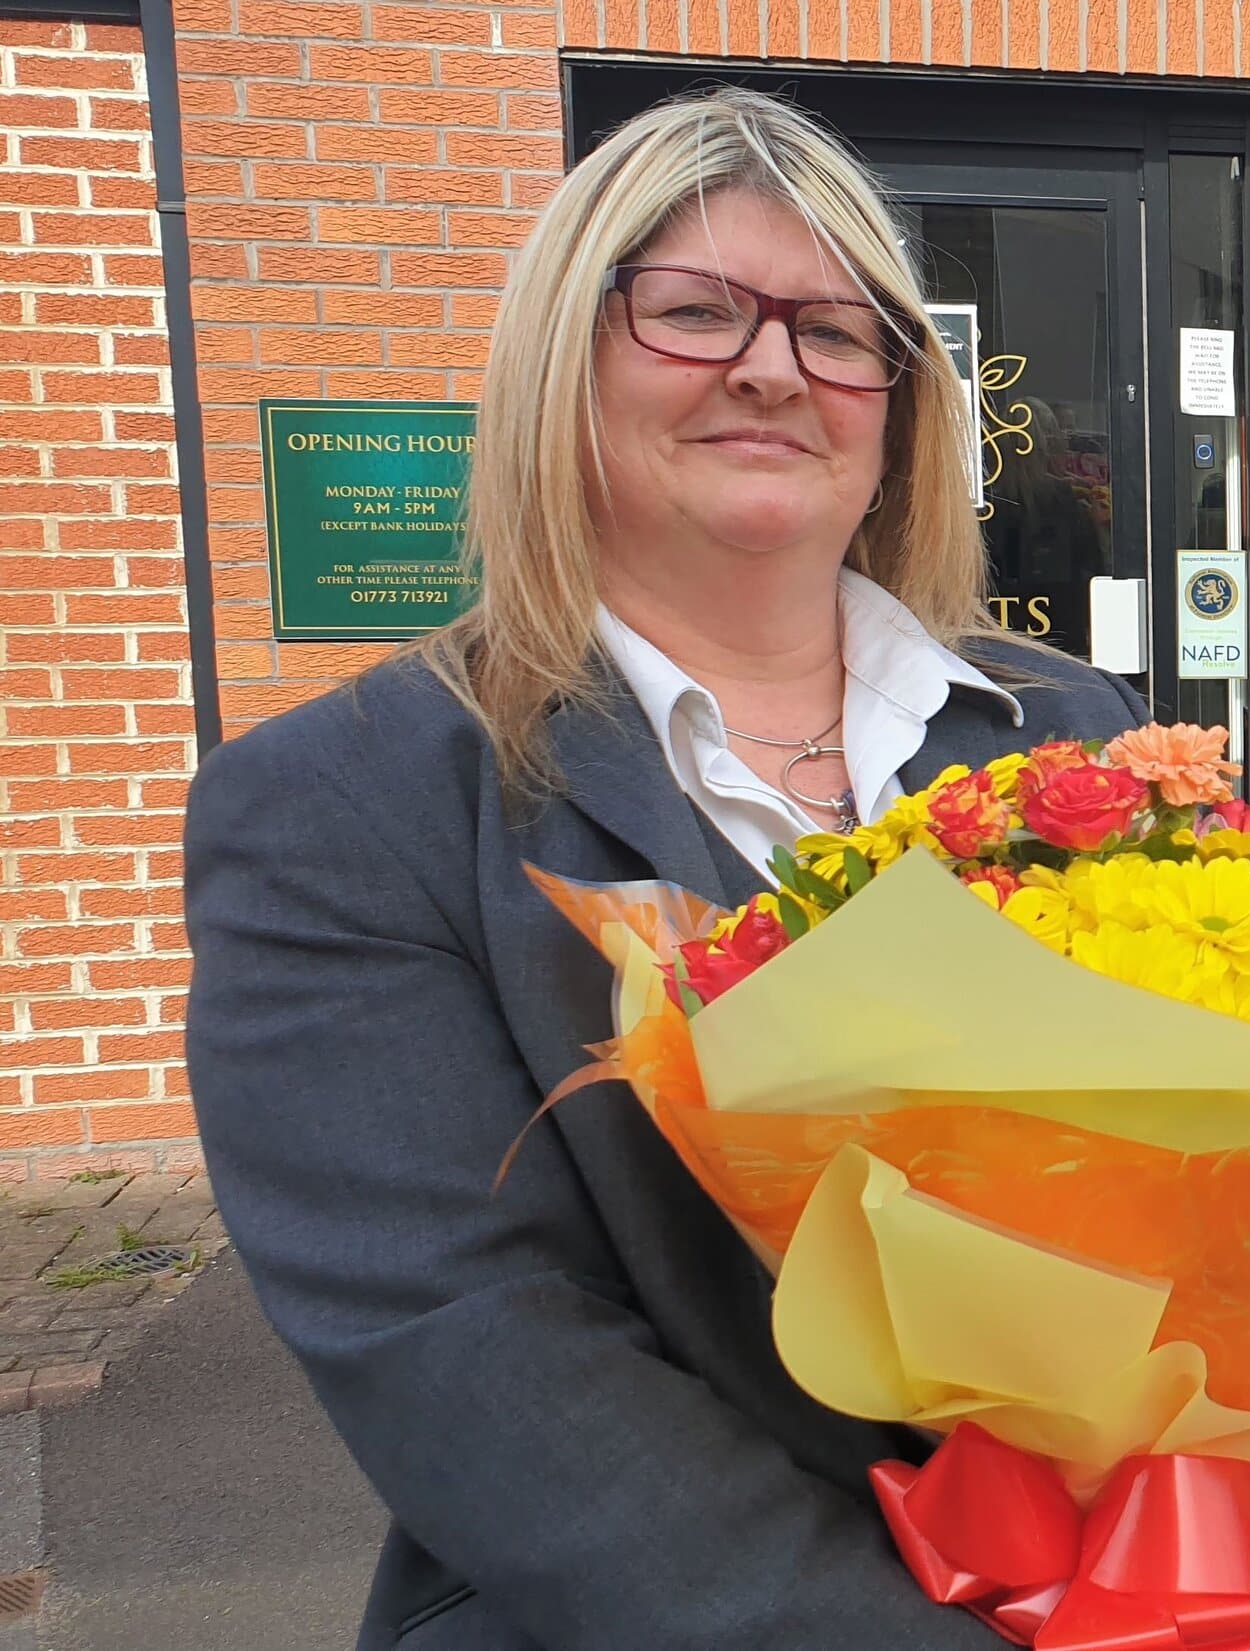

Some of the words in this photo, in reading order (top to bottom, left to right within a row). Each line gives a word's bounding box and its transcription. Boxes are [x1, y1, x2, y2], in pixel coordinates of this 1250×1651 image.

[288, 433, 401, 452] OPENING
[407, 434, 476, 454] HOUR
[326, 486, 396, 498] MONDAY
[404, 486, 460, 498] FRIDAY
[353, 502, 390, 514] 9AM
[404, 502, 436, 514] 5PM
[371, 522, 404, 531] BANK
[334, 564, 354, 573] FOR
[358, 564, 420, 574] ASSISTANCE
[423, 565, 437, 574] AT
[438, 565, 461, 574] ANY
[317, 576, 353, 584] OTHER
[356, 576, 381, 584] TIME
[384, 576, 418, 585] PLEASE
[351, 590, 397, 603] 01773
[402, 590, 448, 603] 713921
[1182, 645, 1240, 662] NAFD
